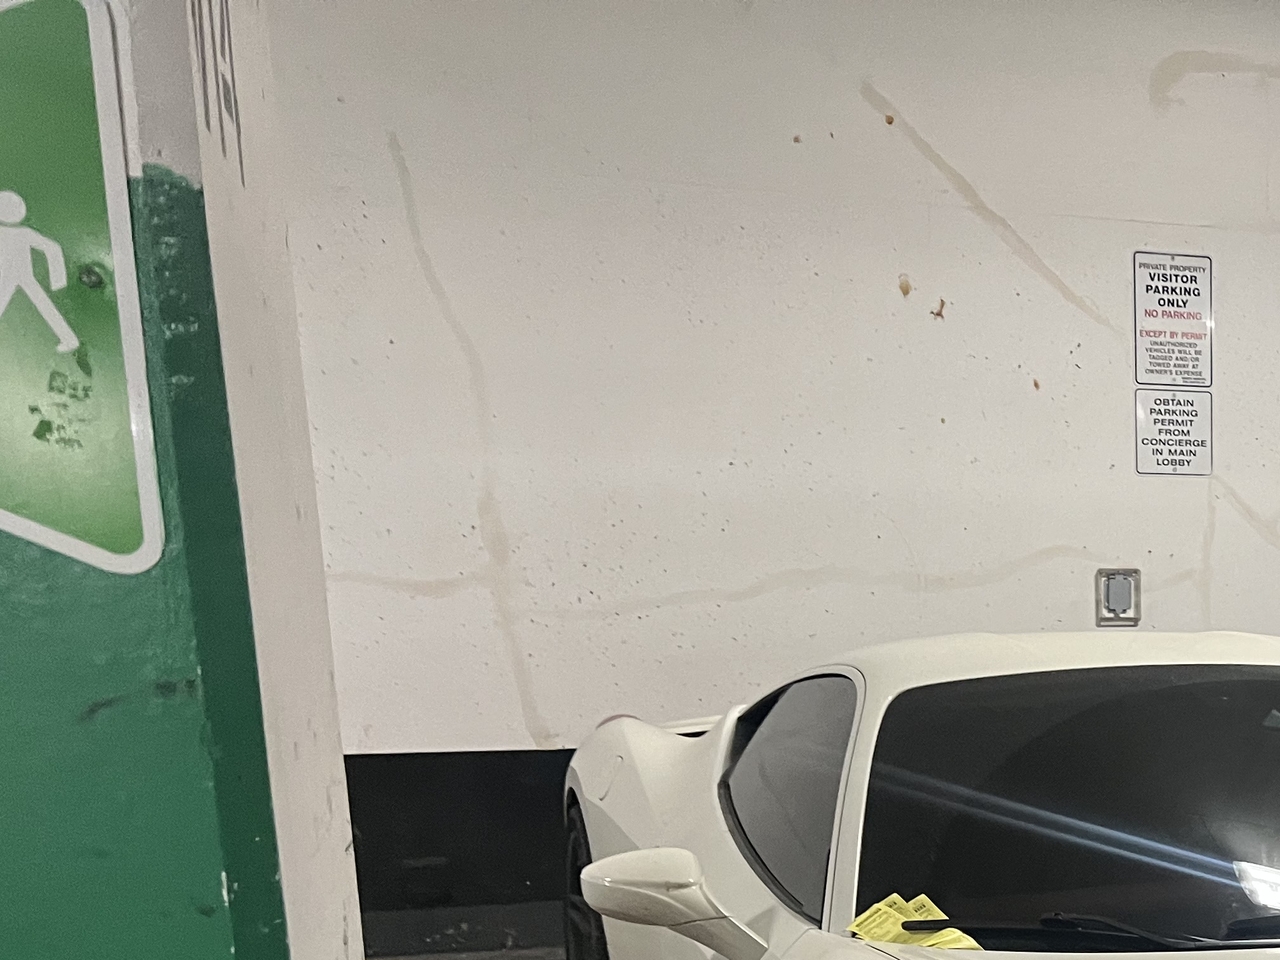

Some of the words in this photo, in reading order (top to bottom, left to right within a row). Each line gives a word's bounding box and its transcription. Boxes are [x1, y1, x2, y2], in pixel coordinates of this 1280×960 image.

[1139, 263, 1167, 271] PRIVATE
[1170, 265, 1207, 273] PROPERTY
[1149, 272, 1198, 284] VISITOR
[1146, 285, 1201, 296] PARKING
[1158, 298, 1189, 308] ONLY
[1144, 309, 1159, 318] NO
[1162, 310, 1202, 319] PARKING
[1139, 330, 1167, 338] EXCEPT
[1149, 341, 1198, 349] UNAUTHORIZED
[1148, 353, 1173, 362] TAGGED
[1144, 368, 1173, 376] OWNER'S
[1154, 398, 1194, 407] OBTAIN
[1150, 408, 1198, 417] PARKING
[1154, 418, 1194, 427] PERMIT
[1159, 429, 1190, 437] FROM
[1142, 438, 1207, 447] CONCIERGE
[1151, 448, 1164, 456] IN
[1169, 449, 1196, 457] MAIN
[1157, 459, 1191, 467] LOBBY
